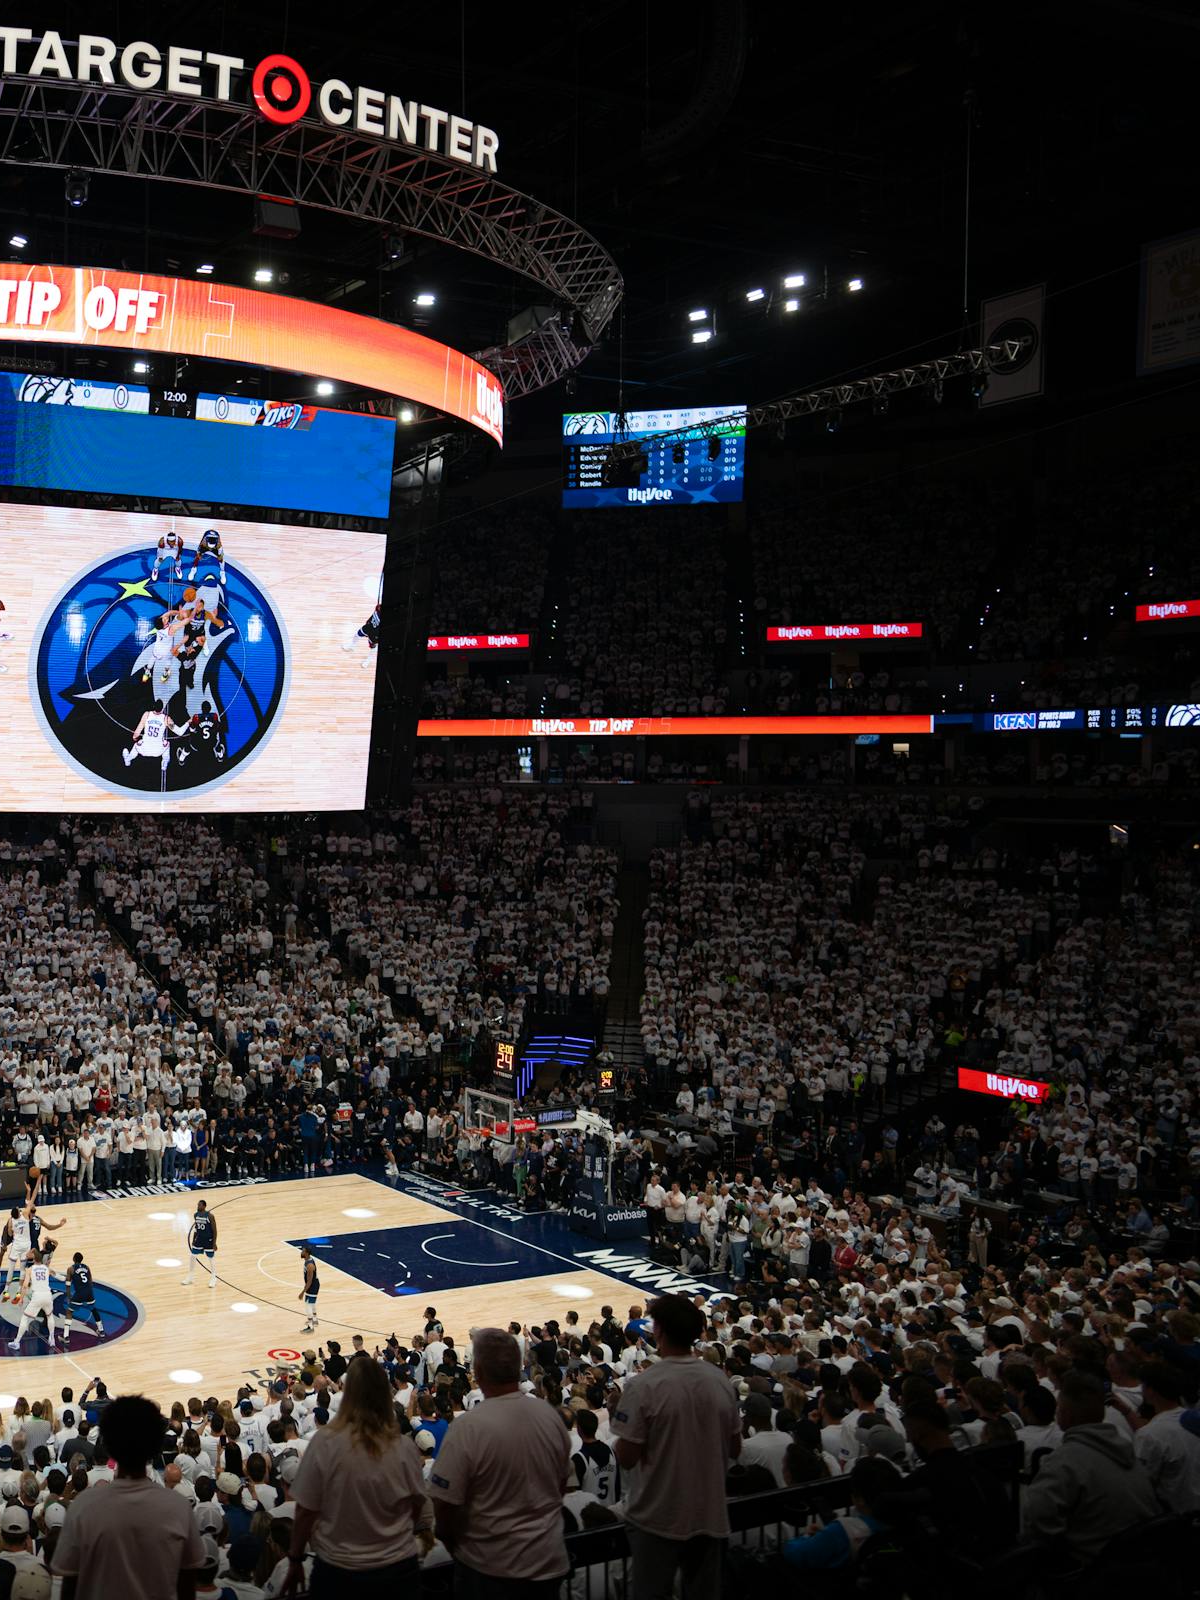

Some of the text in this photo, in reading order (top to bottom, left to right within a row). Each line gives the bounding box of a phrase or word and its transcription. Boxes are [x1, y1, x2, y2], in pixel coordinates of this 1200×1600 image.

[319, 79, 500, 173] CENTER
[84, 285, 160, 333] OFF
[84, 389, 91, 398] 0
[114, 385, 129, 409] 0
[163, 391, 187, 403] 12:00
[215, 396, 229, 420] 0
[251, 407, 256, 416] 0
[263, 405, 295, 427] OKC
[628, 487, 671, 503] HyVee
[1149, 604, 1187, 618] HyVee
[778, 624, 908, 640] HyVee HyVee HyVee
[448, 637, 478, 649] HyVee
[488, 635, 518, 647] HyVee
[994, 713, 1036, 730] KFAN
[1039, 712, 1059, 720] SPORTS
[148, 726, 160, 737] 55
[203, 728, 210, 739] 5
[532, 719, 634, 734] HyVee TIP OFF
[498, 1042, 514, 1055] 12:00
[496, 1052, 512, 1071] 24
[987, 1073, 1038, 1098] HyVee
[197, 1176, 268, 1187] Google
[106, 1182, 191, 1199] PLAYOFFS
[456, 1195, 524, 1222] ULTRA
[607, 1209, 648, 1222] coinbase
[35, 1271, 46, 1281] 55
[80, 1273, 88, 1283] 5
[247, 1439, 255, 1451] 5
[598, 1477, 608, 1499] 5
